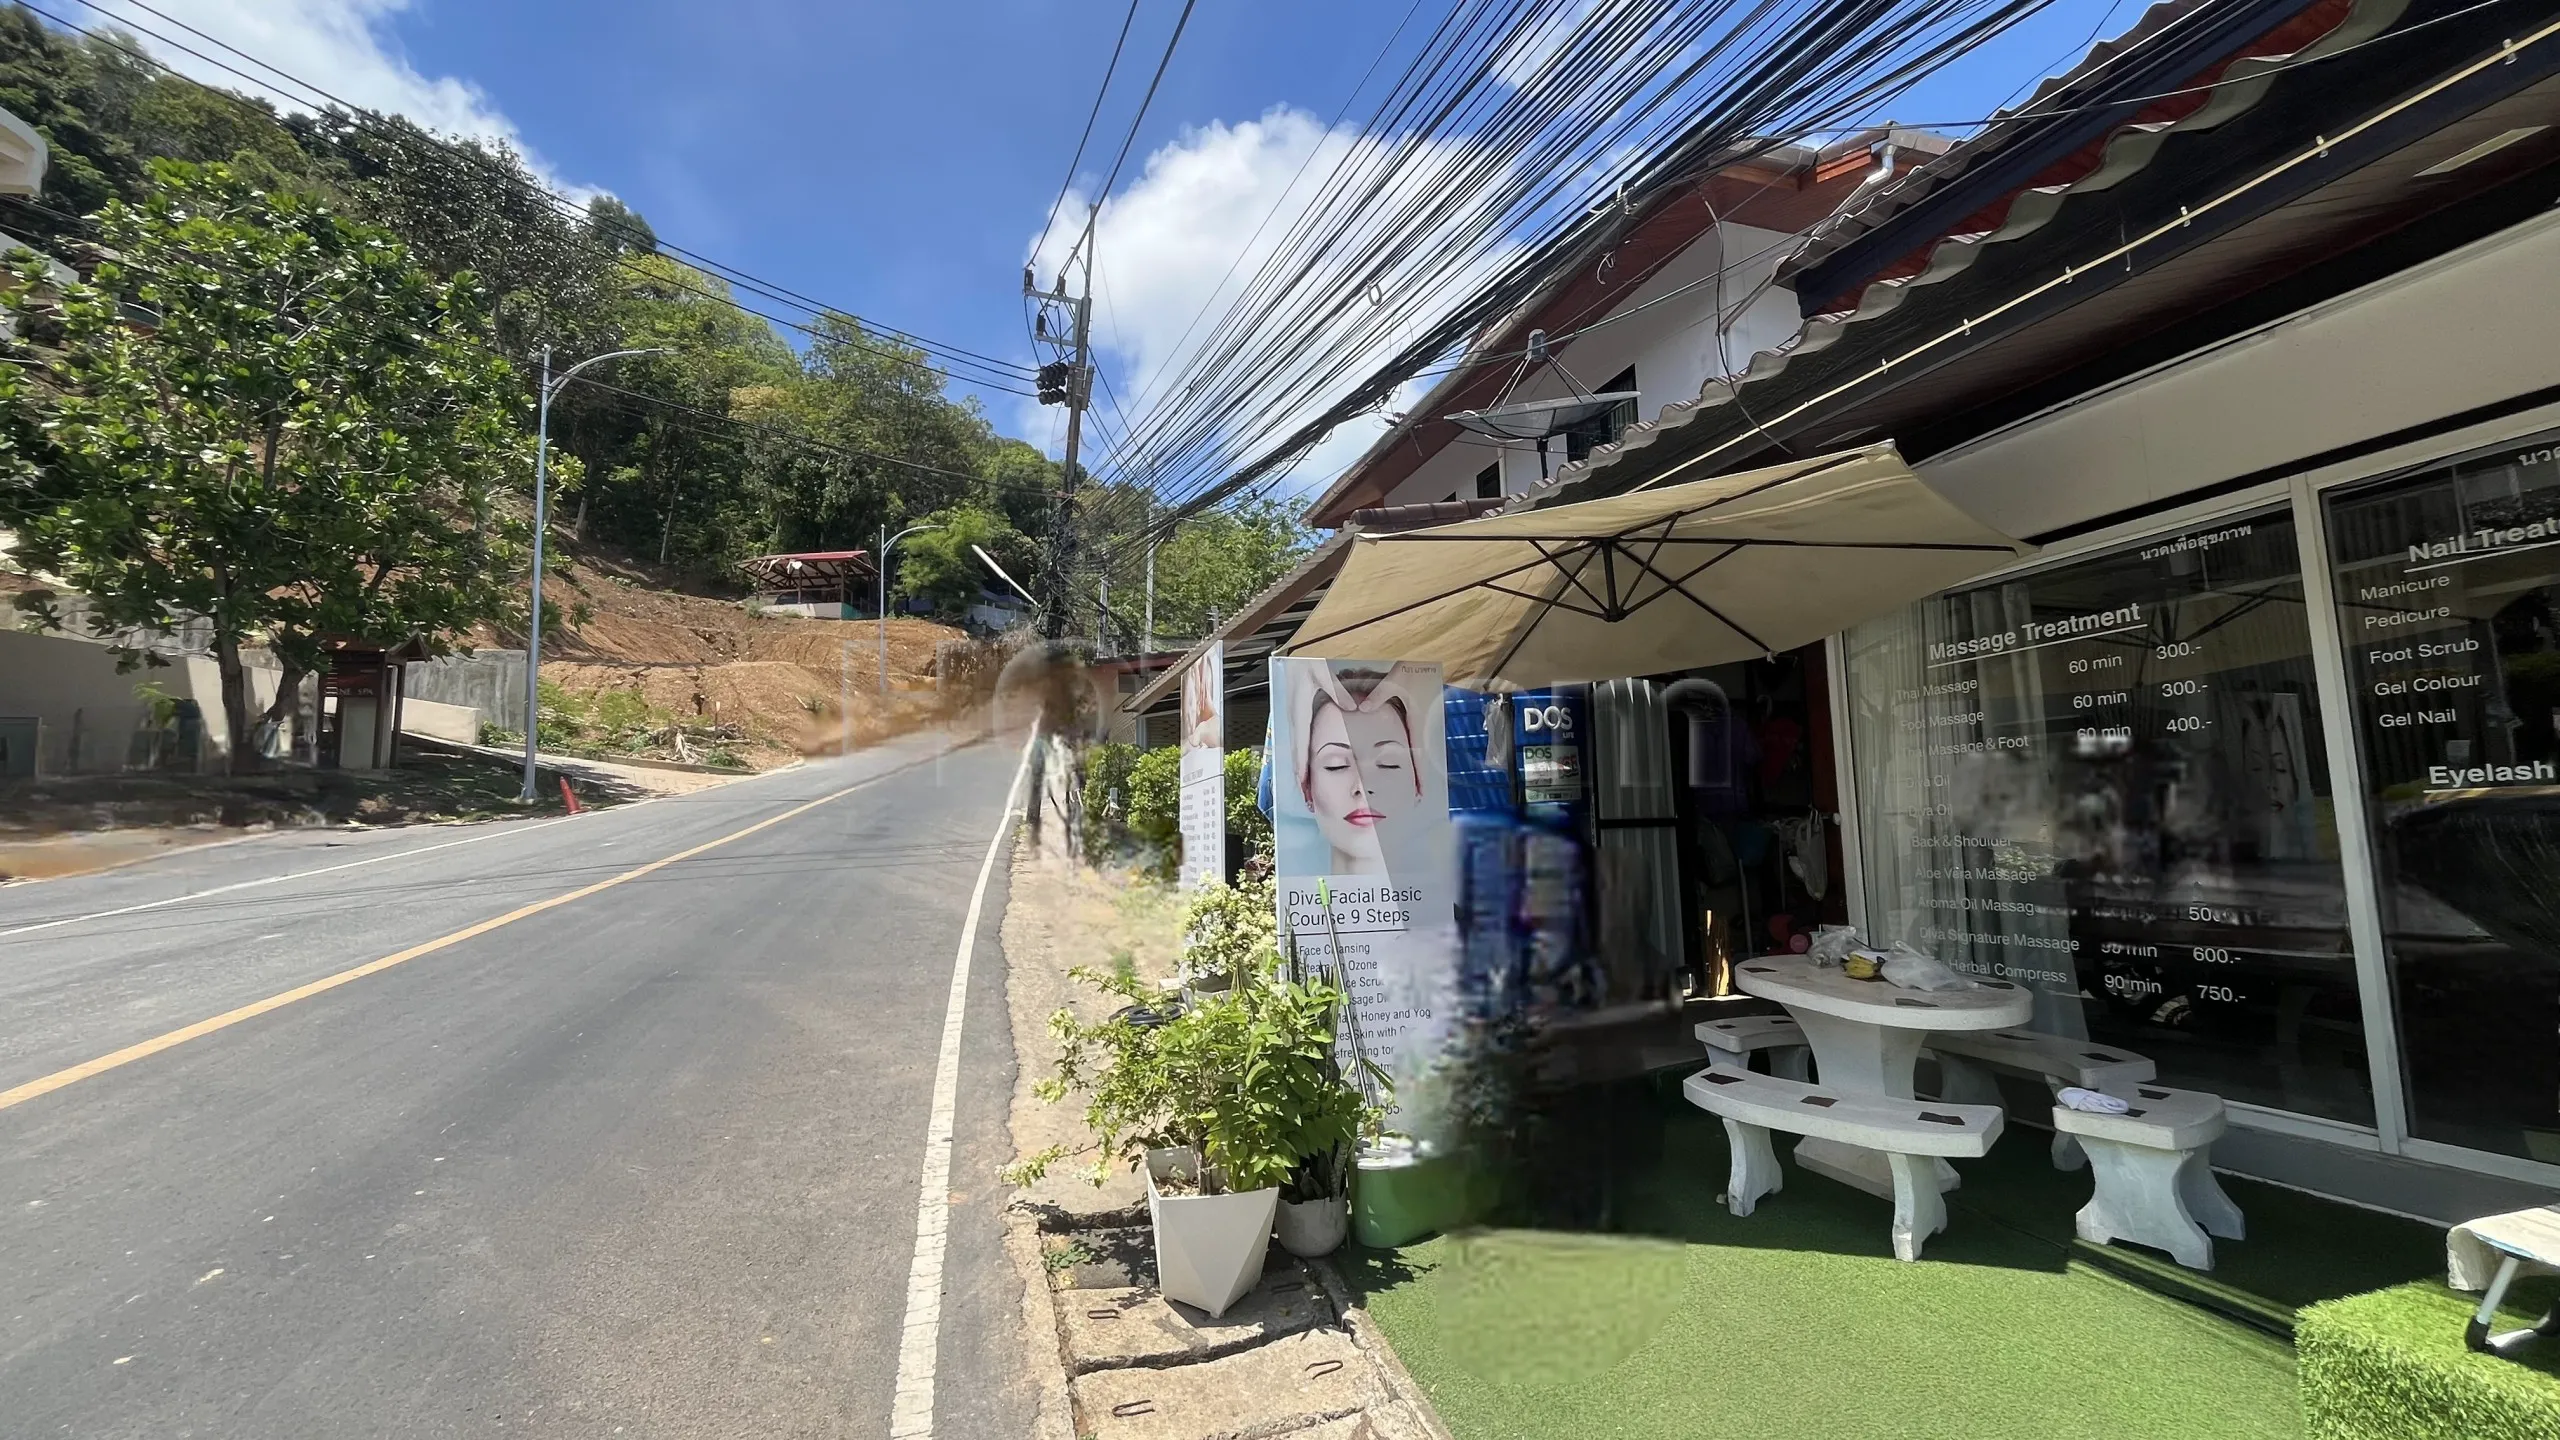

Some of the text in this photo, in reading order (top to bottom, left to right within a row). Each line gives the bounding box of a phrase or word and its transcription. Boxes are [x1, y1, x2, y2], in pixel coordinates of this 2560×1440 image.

[2141, 525, 2252, 562] นวดเพื่อสุขภาพ
[2409, 535, 2466, 562] Nail
[2360, 573, 2450, 601] Manicure
[2364, 604, 2450, 629] Pedicure
[1929, 602, 2141, 661] Massage Treatment
[2369, 637, 2480, 665] Foot Scrub
[1922, 679, 1978, 697] Massage
[2068, 657, 2089, 675] 60
[2093, 652, 2123, 671] min
[2156, 642, 2203, 661] 300.-
[2374, 672, 2482, 696] Gel Colour
[1929, 711, 1985, 728] Massage
[2073, 693, 2092, 710] 60
[2097, 688, 2128, 707] min
[2161, 679, 2208, 697] 300.-
[1524, 705, 1573, 732] DOS
[2379, 708, 2457, 728] Gel Nail
[1929, 742, 1984, 758] Massage
[1985, 738, 1996, 751] &
[1998, 735, 2029, 750] Foot
[2076, 727, 2097, 742] 60
[2101, 723, 2131, 740] min
[2166, 716, 2213, 734] 400.-
[1525, 747, 1552, 759] DOS
[2429, 760, 2554, 790] Eyelash
[1912, 836, 1941, 848] Back
[1942, 836, 1953, 847] &
[1915, 867, 2037, 884] Aloe Vera Massage
[1289, 887, 1422, 906] Diva Facial Basic
[1918, 897, 1957, 910] Aroma
[1960, 898, 1978, 910] Oil
[1290, 908, 1410, 926] Course 9 Steps
[1299, 945, 1321, 956] Face
[1919, 927, 1946, 939] Diva
[1948, 929, 2010, 945] Signature
[2013, 934, 2080, 954] Massage
[2193, 946, 2242, 964] 600.-
[1348, 960, 1378, 971] Ozone
[1359, 977, 1384, 988] Scru
[1948, 958, 2246, 1002] Herbal Compress 90 min 750.-
[1361, 1011, 1391, 1022] Honey
[1394, 1009, 1411, 1019] and
[1414, 1008, 1431, 1019] Yog
[1353, 1028, 1374, 1039] Skin
[1377, 1026, 1397, 1037] with
